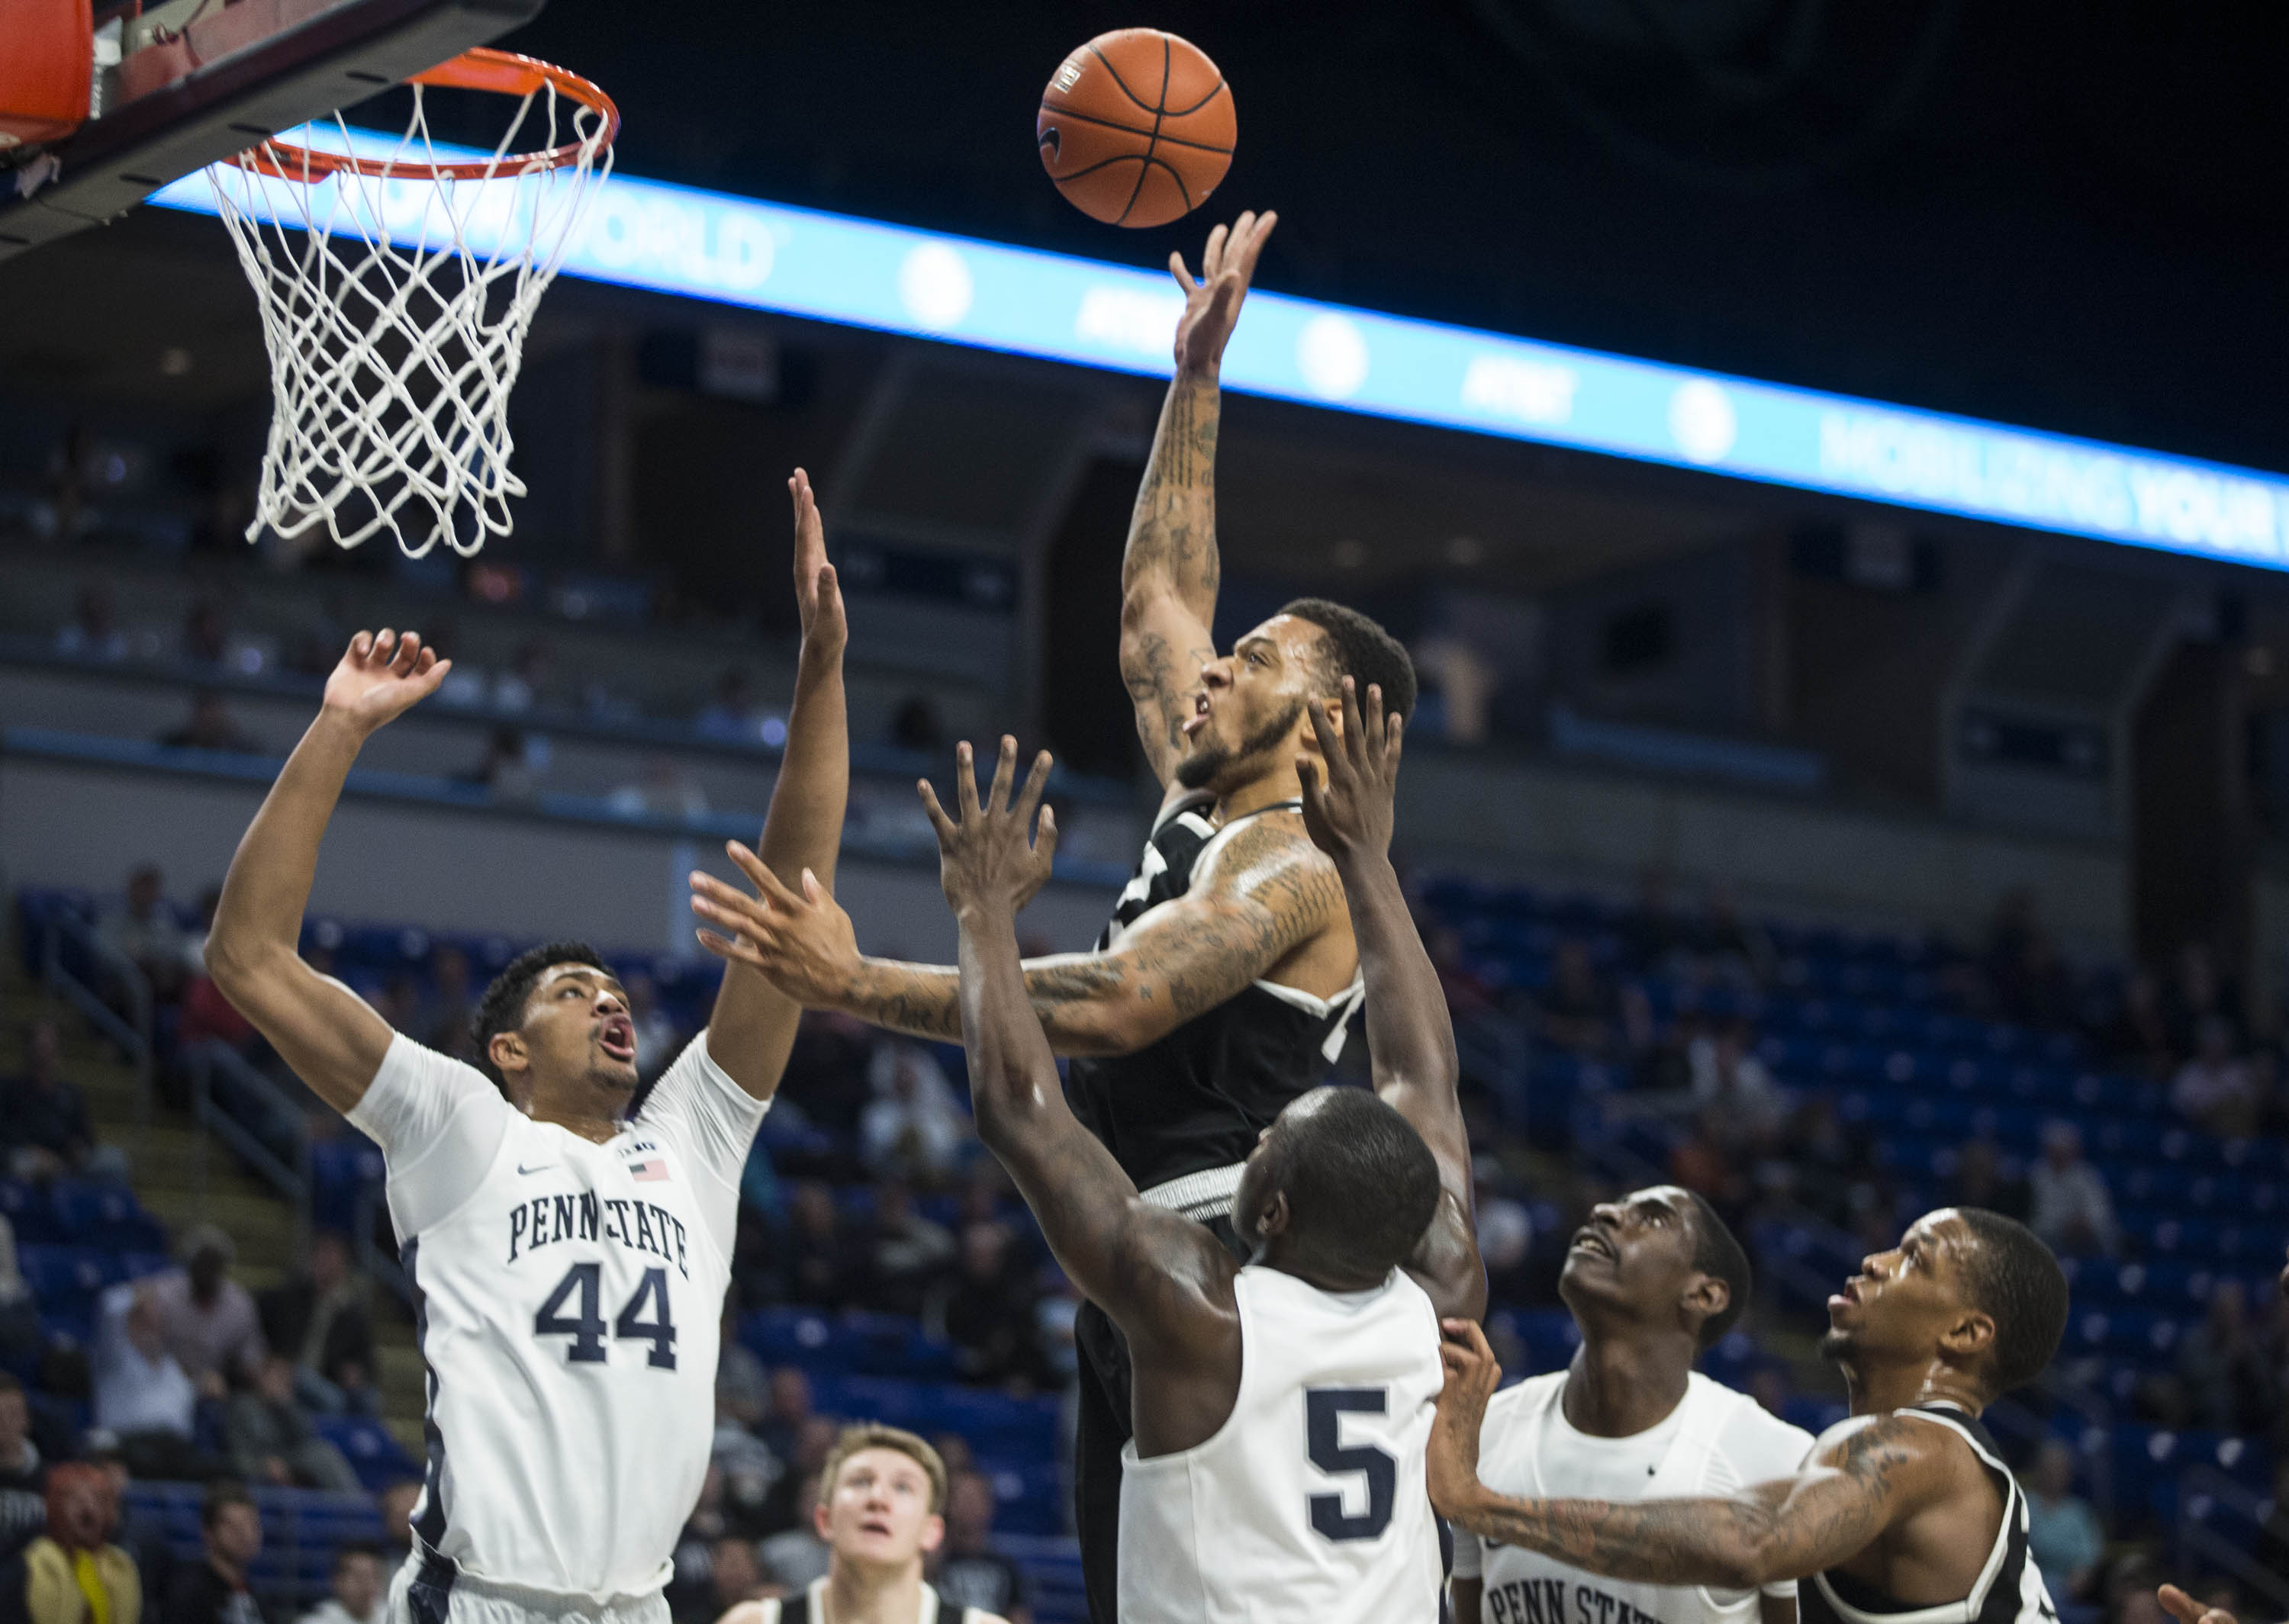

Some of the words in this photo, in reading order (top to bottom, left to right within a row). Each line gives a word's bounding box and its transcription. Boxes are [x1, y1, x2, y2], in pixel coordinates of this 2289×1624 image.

[508, 1187, 599, 1265] PENN
[535, 1261, 678, 1372] 44
[1302, 1385, 1398, 1543] 5
[1489, 1578, 1566, 1624] PENN
